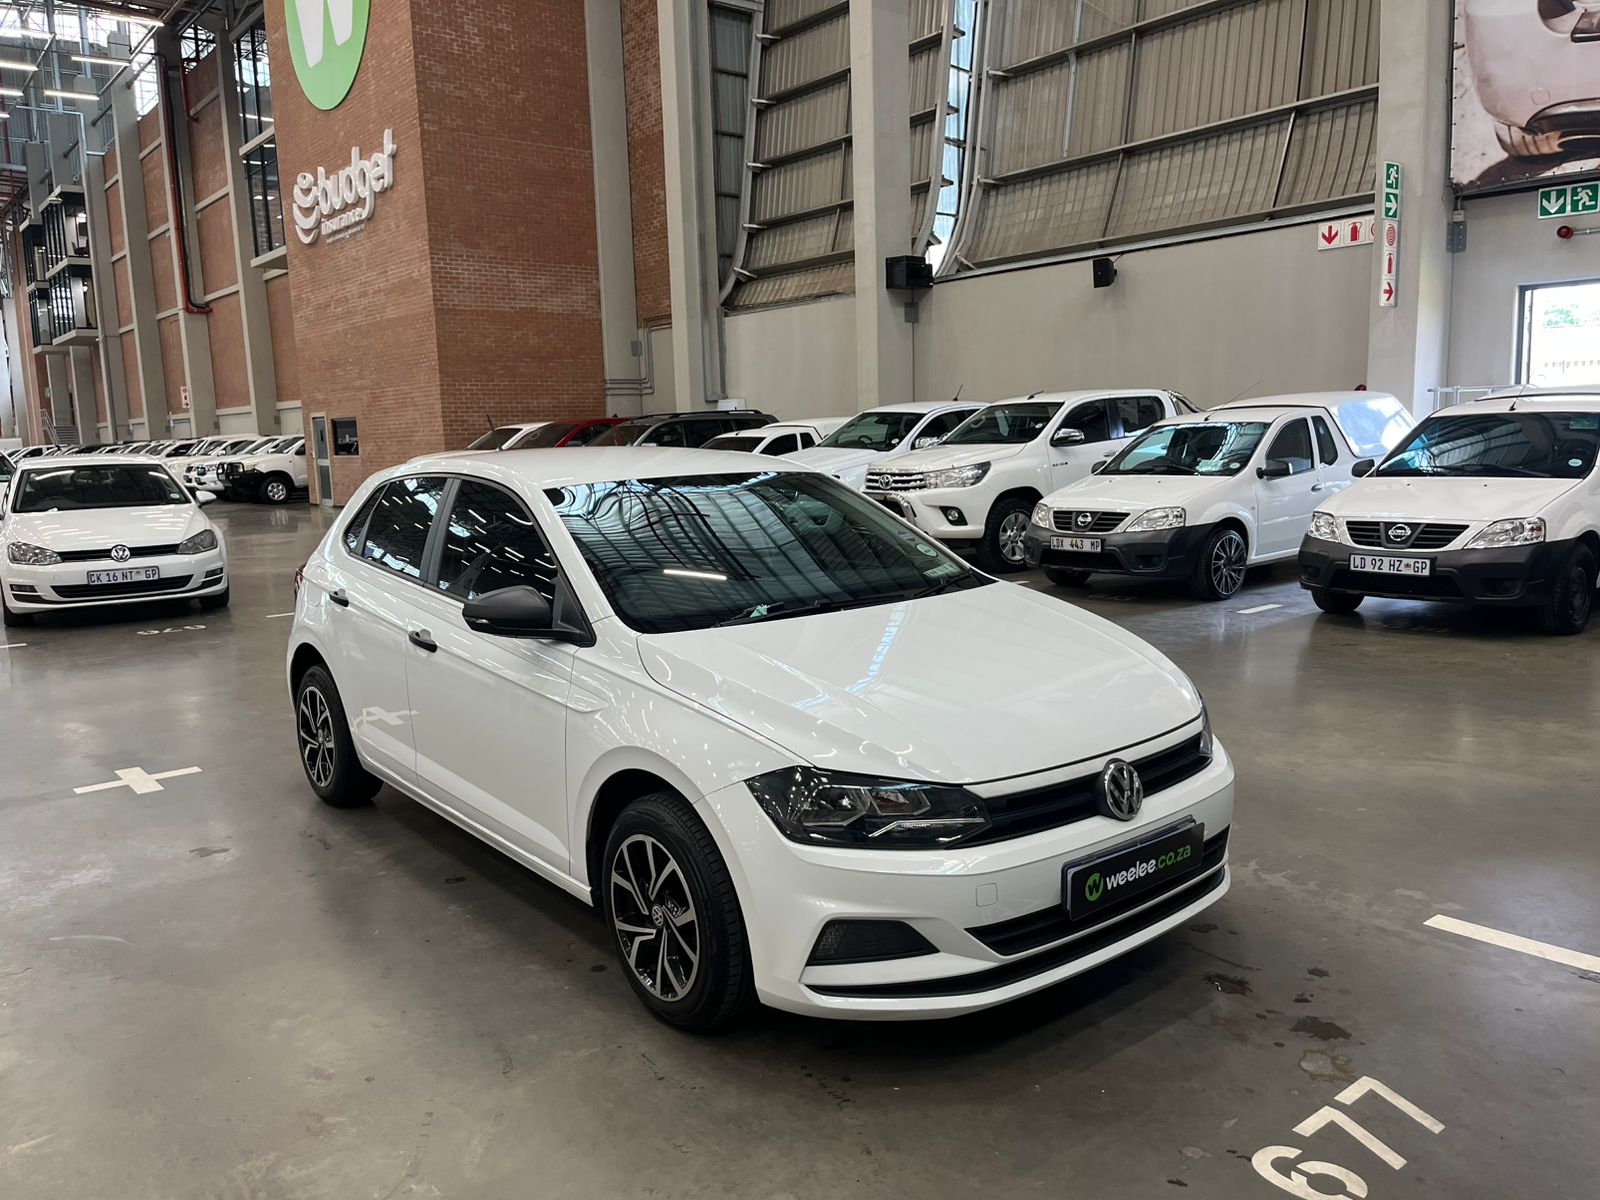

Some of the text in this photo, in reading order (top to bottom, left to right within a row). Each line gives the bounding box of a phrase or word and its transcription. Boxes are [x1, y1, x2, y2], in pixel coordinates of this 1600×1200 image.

[317, 128, 397, 219] budget
[90, 568, 157, 584] CK 16 NT GP
[1353, 556, 1427, 574] LD 92 HZ GP
[1106, 844, 1192, 891] weelee.co.za
[1251, 1075, 1446, 1200] 677
